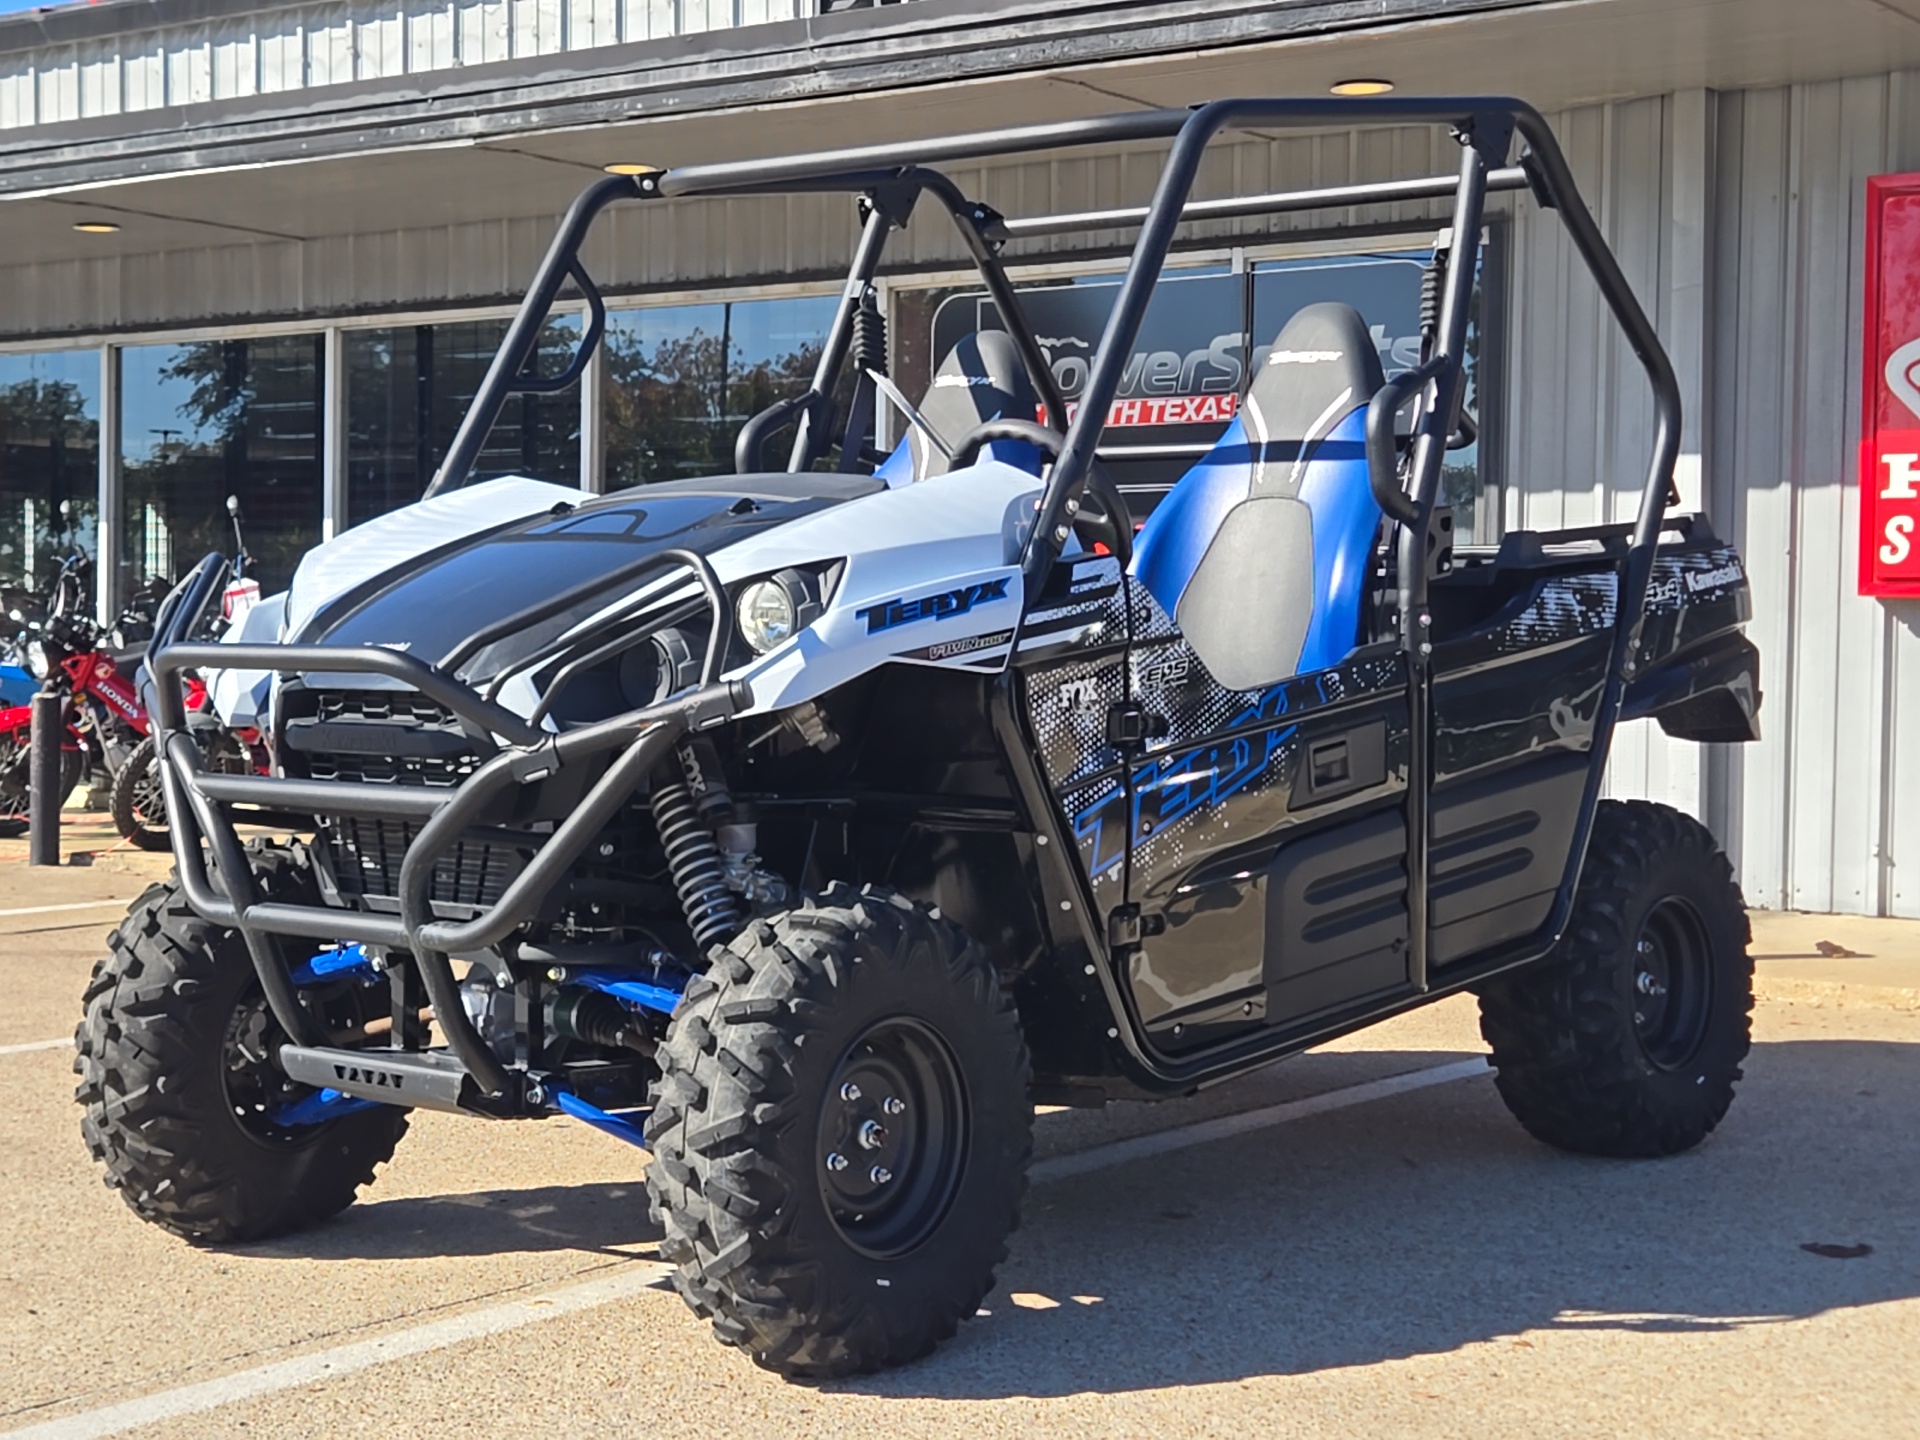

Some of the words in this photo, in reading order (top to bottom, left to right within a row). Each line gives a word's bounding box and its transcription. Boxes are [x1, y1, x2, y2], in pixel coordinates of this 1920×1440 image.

[1146, 396, 1236, 422] TEXAS
[1684, 559, 1743, 593] Kawasaki
[855, 576, 1012, 635] TERYX
[1145, 657, 1190, 687] EPS
[96, 681, 139, 719] HONDA
[1060, 677, 1098, 714] FOX
[681, 745, 706, 798] FOX
